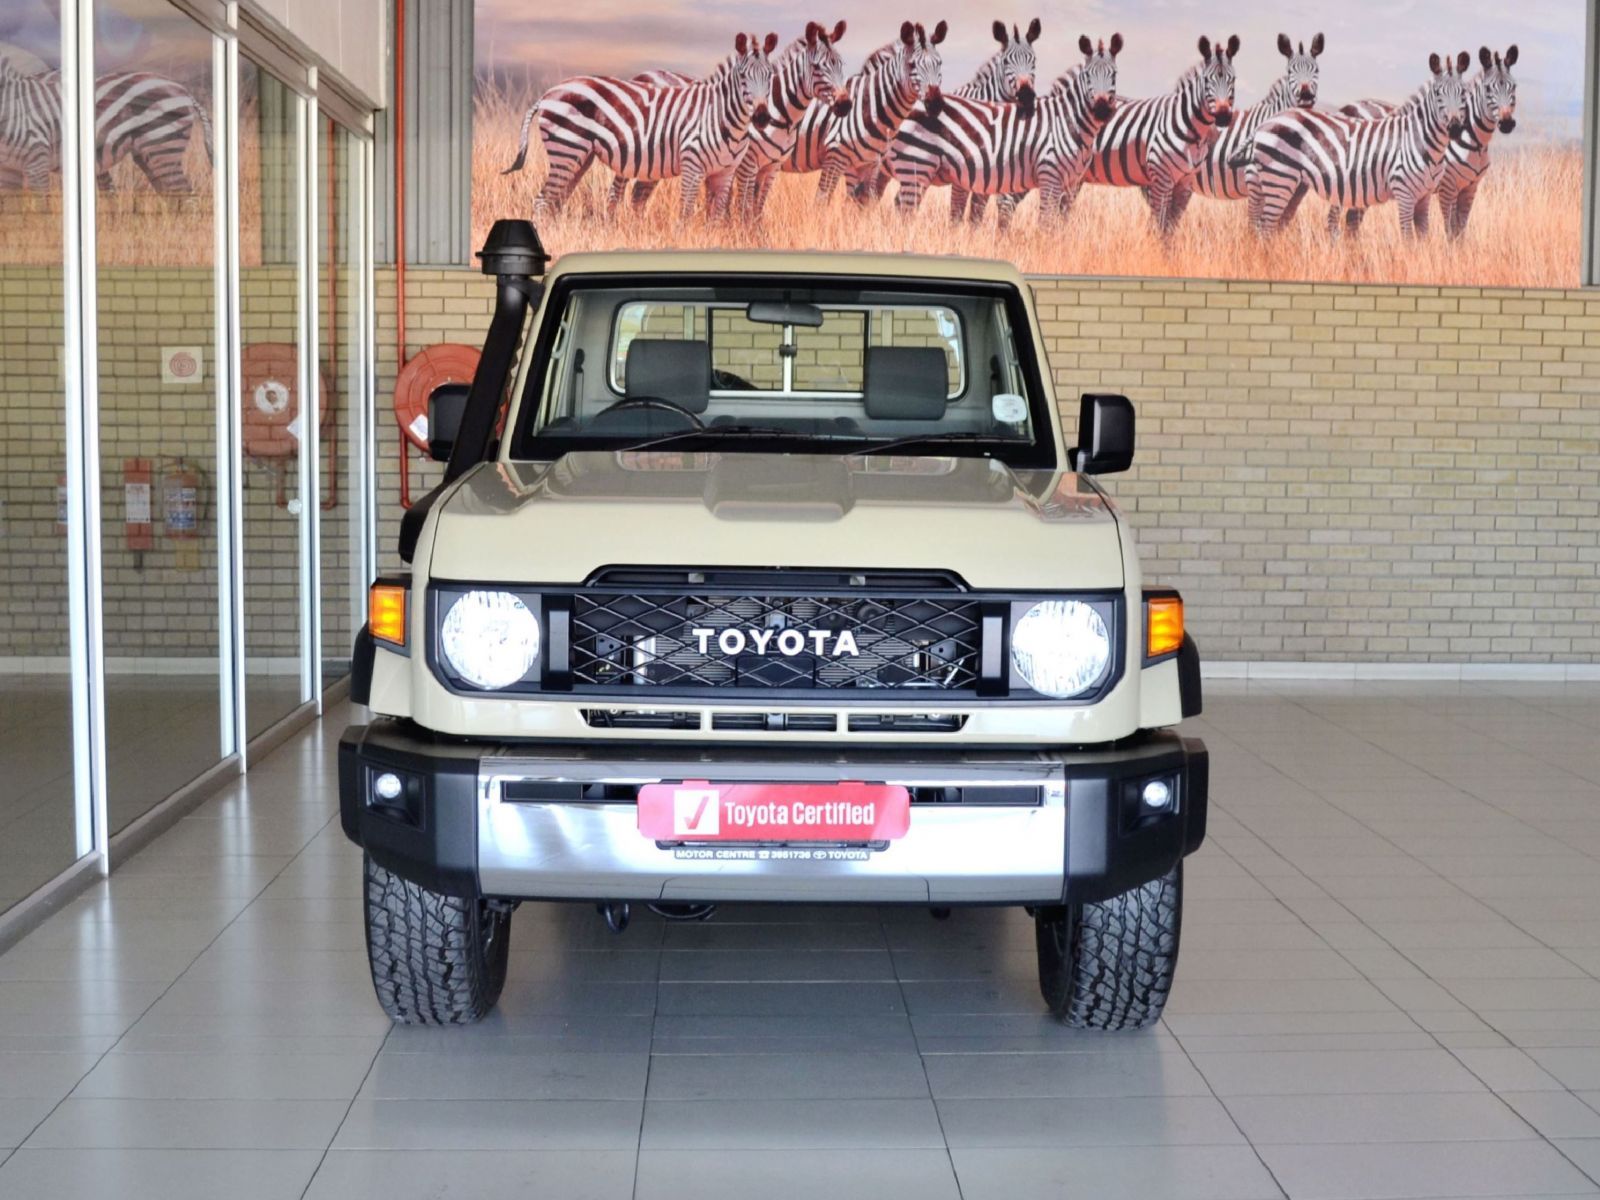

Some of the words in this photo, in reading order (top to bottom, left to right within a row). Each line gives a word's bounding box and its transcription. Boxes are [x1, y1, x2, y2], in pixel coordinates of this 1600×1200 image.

[692, 628, 859, 656] TOYOTA
[725, 802, 788, 827] Toyota
[792, 802, 875, 824] Certified
[675, 850, 713, 859] MOTOR
[716, 850, 755, 859] CENTRE
[828, 851, 868, 859] TOYOTA
